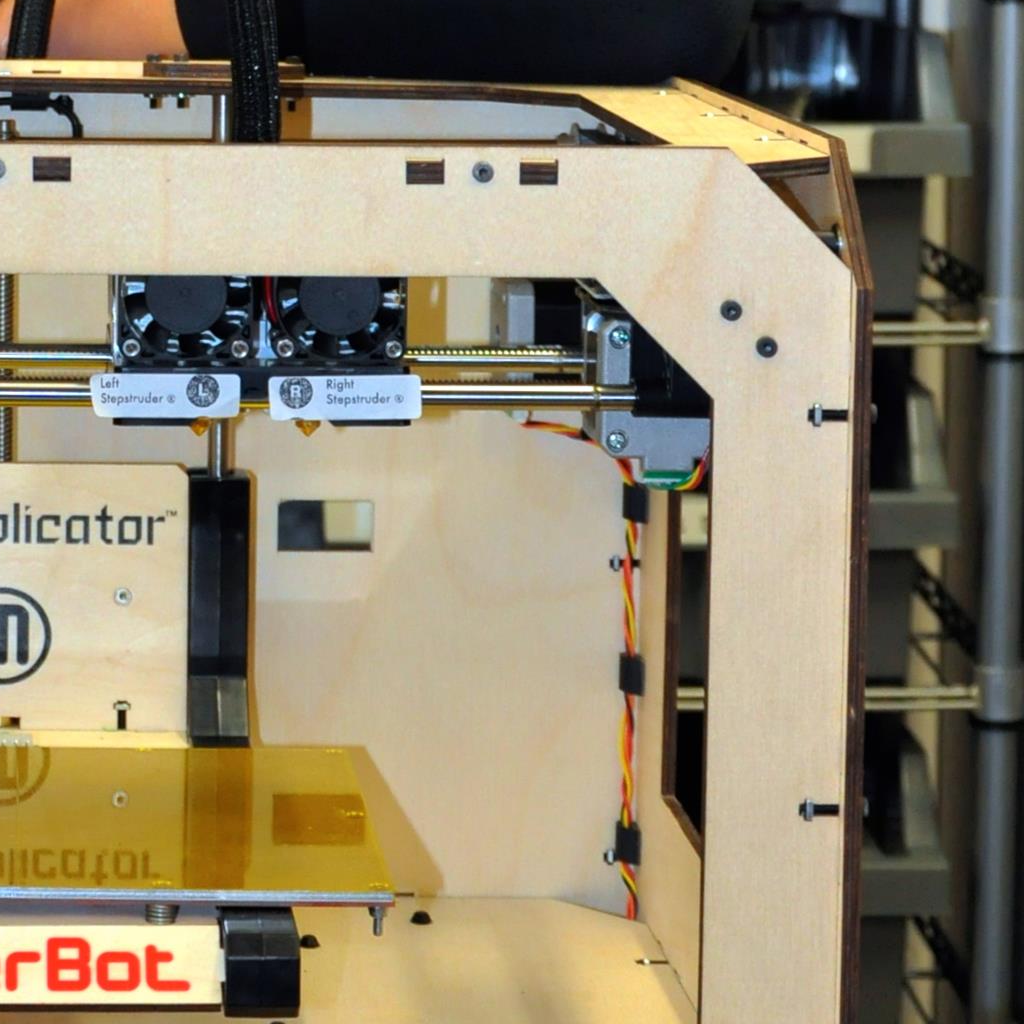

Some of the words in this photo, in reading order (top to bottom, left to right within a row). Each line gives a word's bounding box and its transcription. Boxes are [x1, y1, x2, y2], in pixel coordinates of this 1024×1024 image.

[100, 377, 119, 389] Left
[326, 378, 354, 392] Right
[100, 392, 163, 406] Stepstruder
[326, 391, 390, 407] Stepstruder
